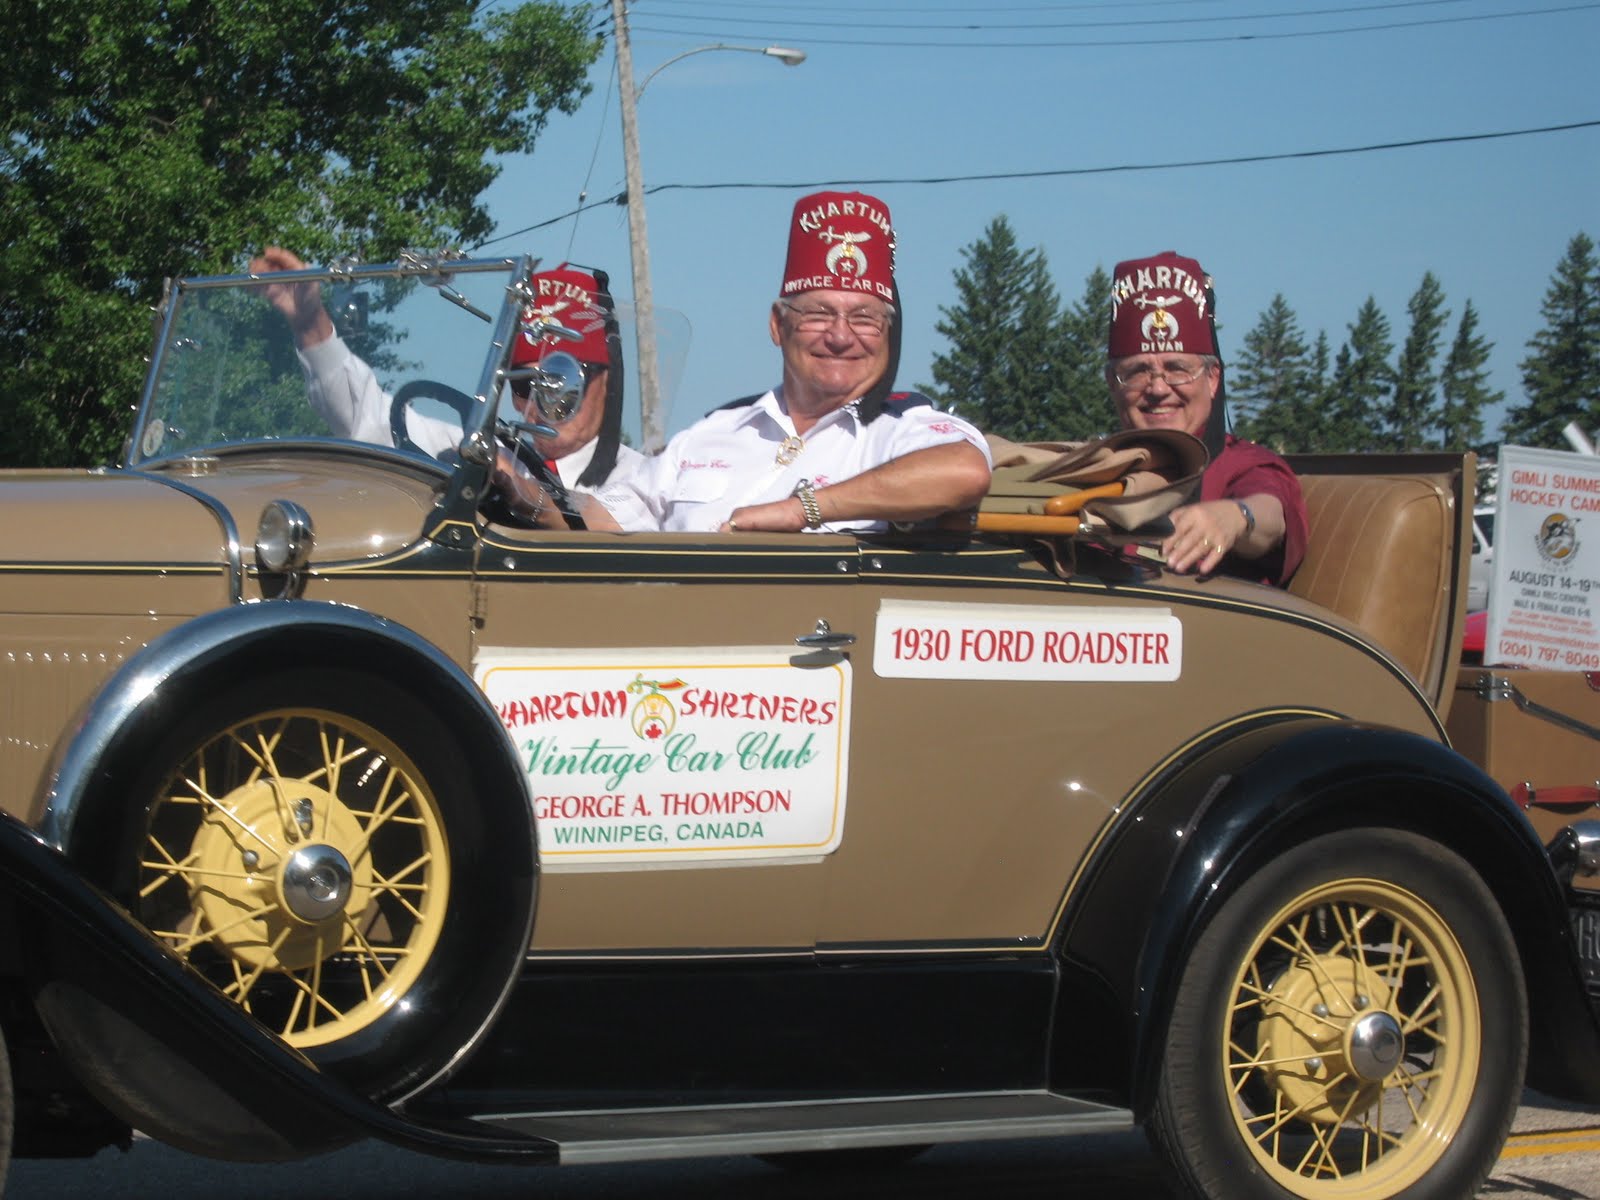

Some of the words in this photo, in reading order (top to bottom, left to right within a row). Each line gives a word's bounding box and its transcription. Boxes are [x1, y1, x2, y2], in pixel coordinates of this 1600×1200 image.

[799, 200, 892, 236] KHARTUM
[538, 278, 592, 309] RTUM
[841, 277, 872, 291] CAR
[1112, 266, 1207, 321] KHARTUM
[1141, 341, 1184, 352] DIVAN
[1512, 470, 1547, 487] GIMLI
[1553, 474, 1600, 494] SUMME
[1510, 489, 1565, 508] HOCKEY
[1571, 495, 1600, 513] CAM
[1509, 570, 1556, 588] AUGUST
[891, 627, 950, 661] 1930
[959, 629, 1035, 662] FORD
[1042, 631, 1170, 664] ROADSTER
[1499, 640, 1532, 659] (204)
[1538, 646, 1600, 669] 797-8049
[680, 688, 836, 725] SHRINERS
[520, 735, 654, 791] Vintage
[663, 732, 733, 773] Car
[736, 731, 818, 772] Club
[534, 794, 625, 820] GEORGE
[631, 794, 652, 817] A.
[661, 789, 792, 816] THOMPSON
[554, 824, 669, 844] WINNIPEG,
[676, 820, 764, 841] CANADA
